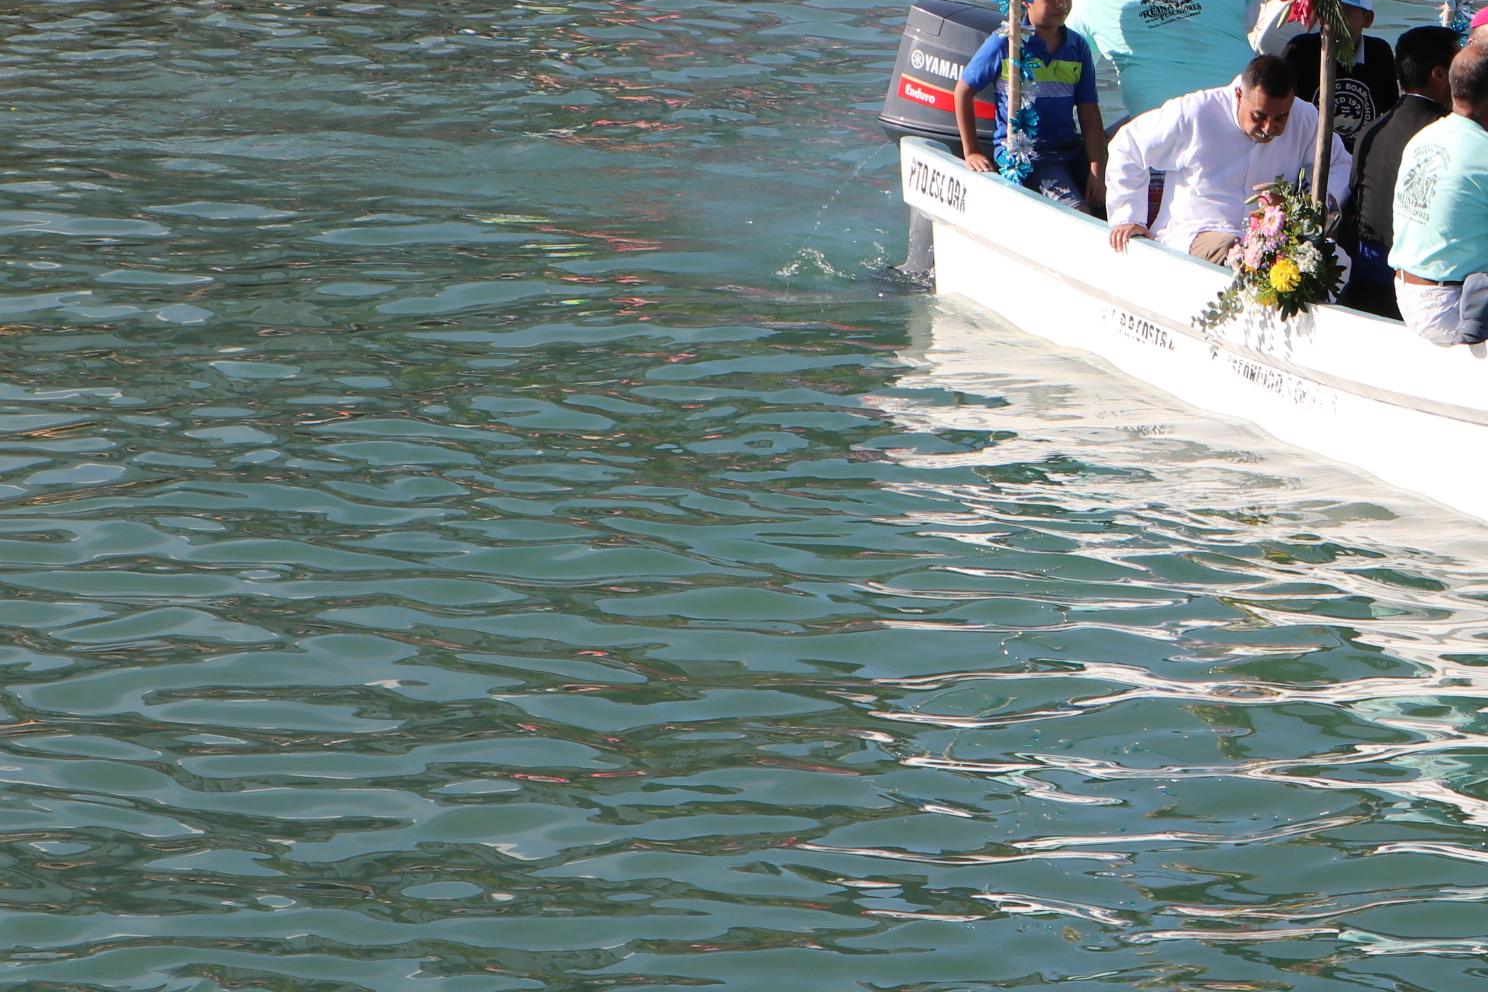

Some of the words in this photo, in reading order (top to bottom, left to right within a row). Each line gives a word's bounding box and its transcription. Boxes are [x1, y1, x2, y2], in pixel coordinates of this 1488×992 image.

[1138, 3, 1174, 19] REINA
[924, 53, 965, 81] YAMA
[904, 83, 936, 105] Enduro
